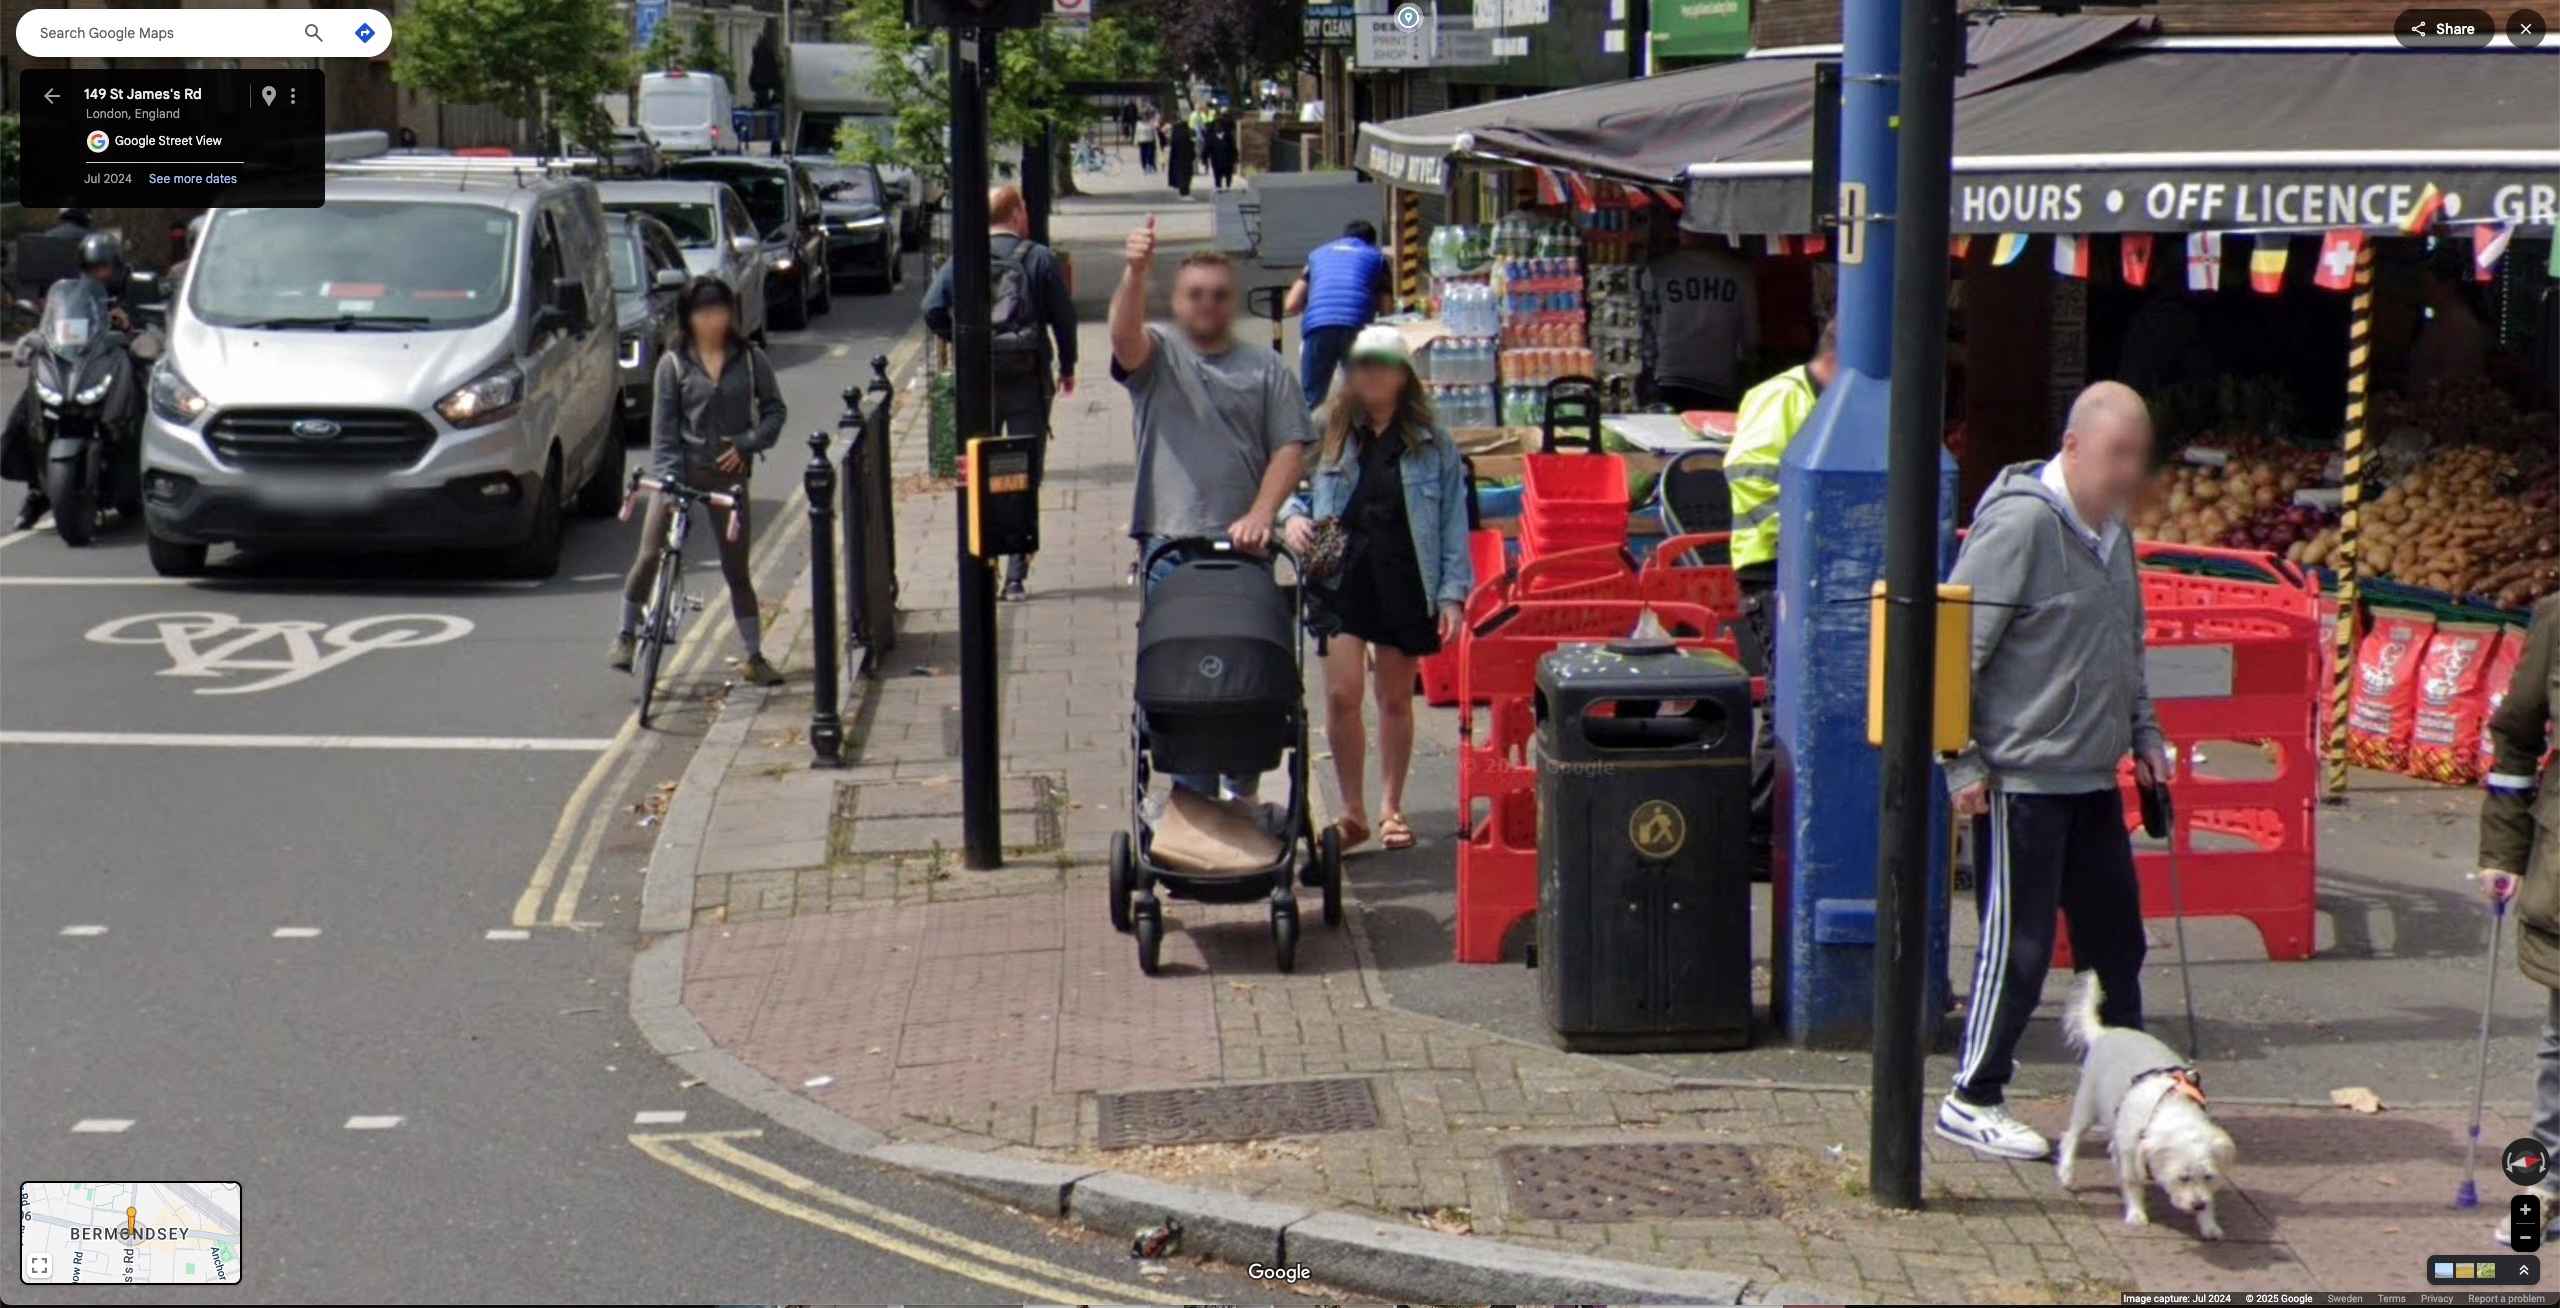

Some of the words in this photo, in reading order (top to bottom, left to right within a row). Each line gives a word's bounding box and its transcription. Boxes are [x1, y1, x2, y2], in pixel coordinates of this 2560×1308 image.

[1963, 184, 2083, 221] HOURS
[2145, 182, 2226, 220] OFF
[2235, 184, 2413, 224] LICENCE
[1666, 276, 1737, 303] SOHO
